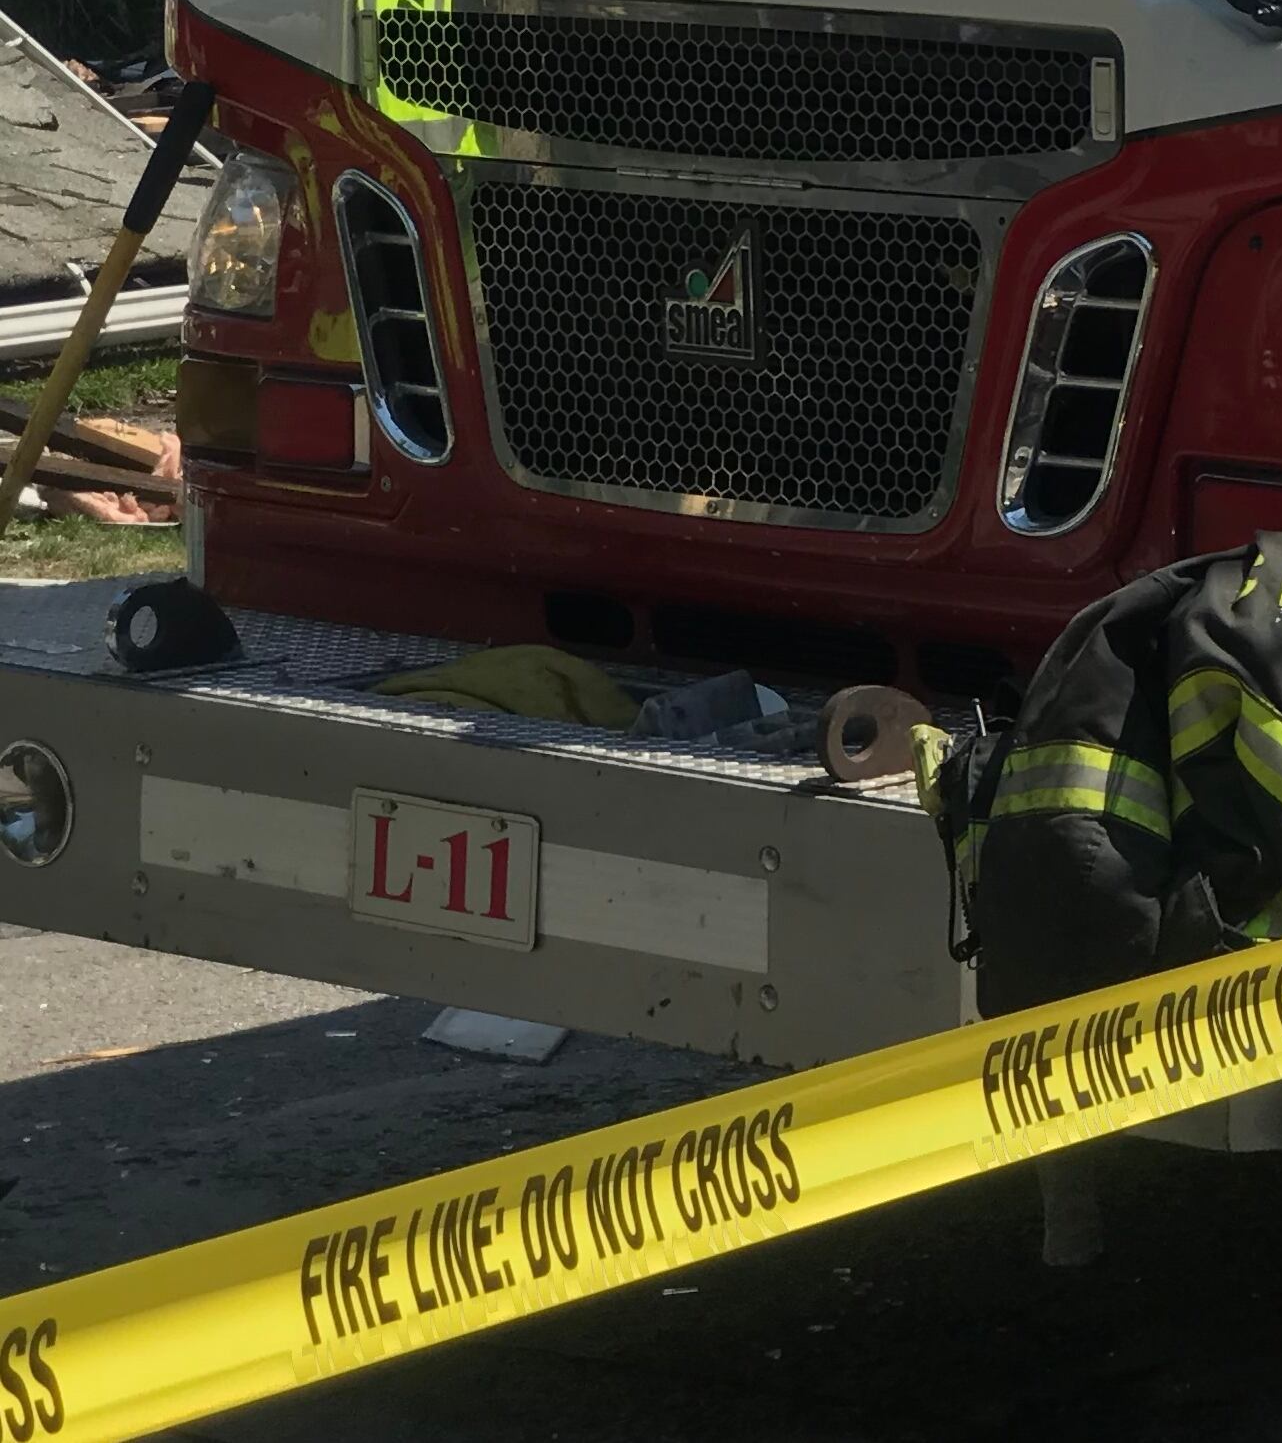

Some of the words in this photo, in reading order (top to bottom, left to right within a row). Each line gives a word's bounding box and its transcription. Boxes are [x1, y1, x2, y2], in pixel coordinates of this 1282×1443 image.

[366, 814, 516, 922] L-11
[982, 1022, 1064, 1135] FIRE
[1154, 983, 1206, 1084] DO
[1205, 963, 1275, 1070] NOT
[299, 1215, 403, 1346] FIRE
[519, 1164, 579, 1281] DO
[585, 1138, 668, 1260] NOT
[670, 1101, 801, 1234] CROSS
